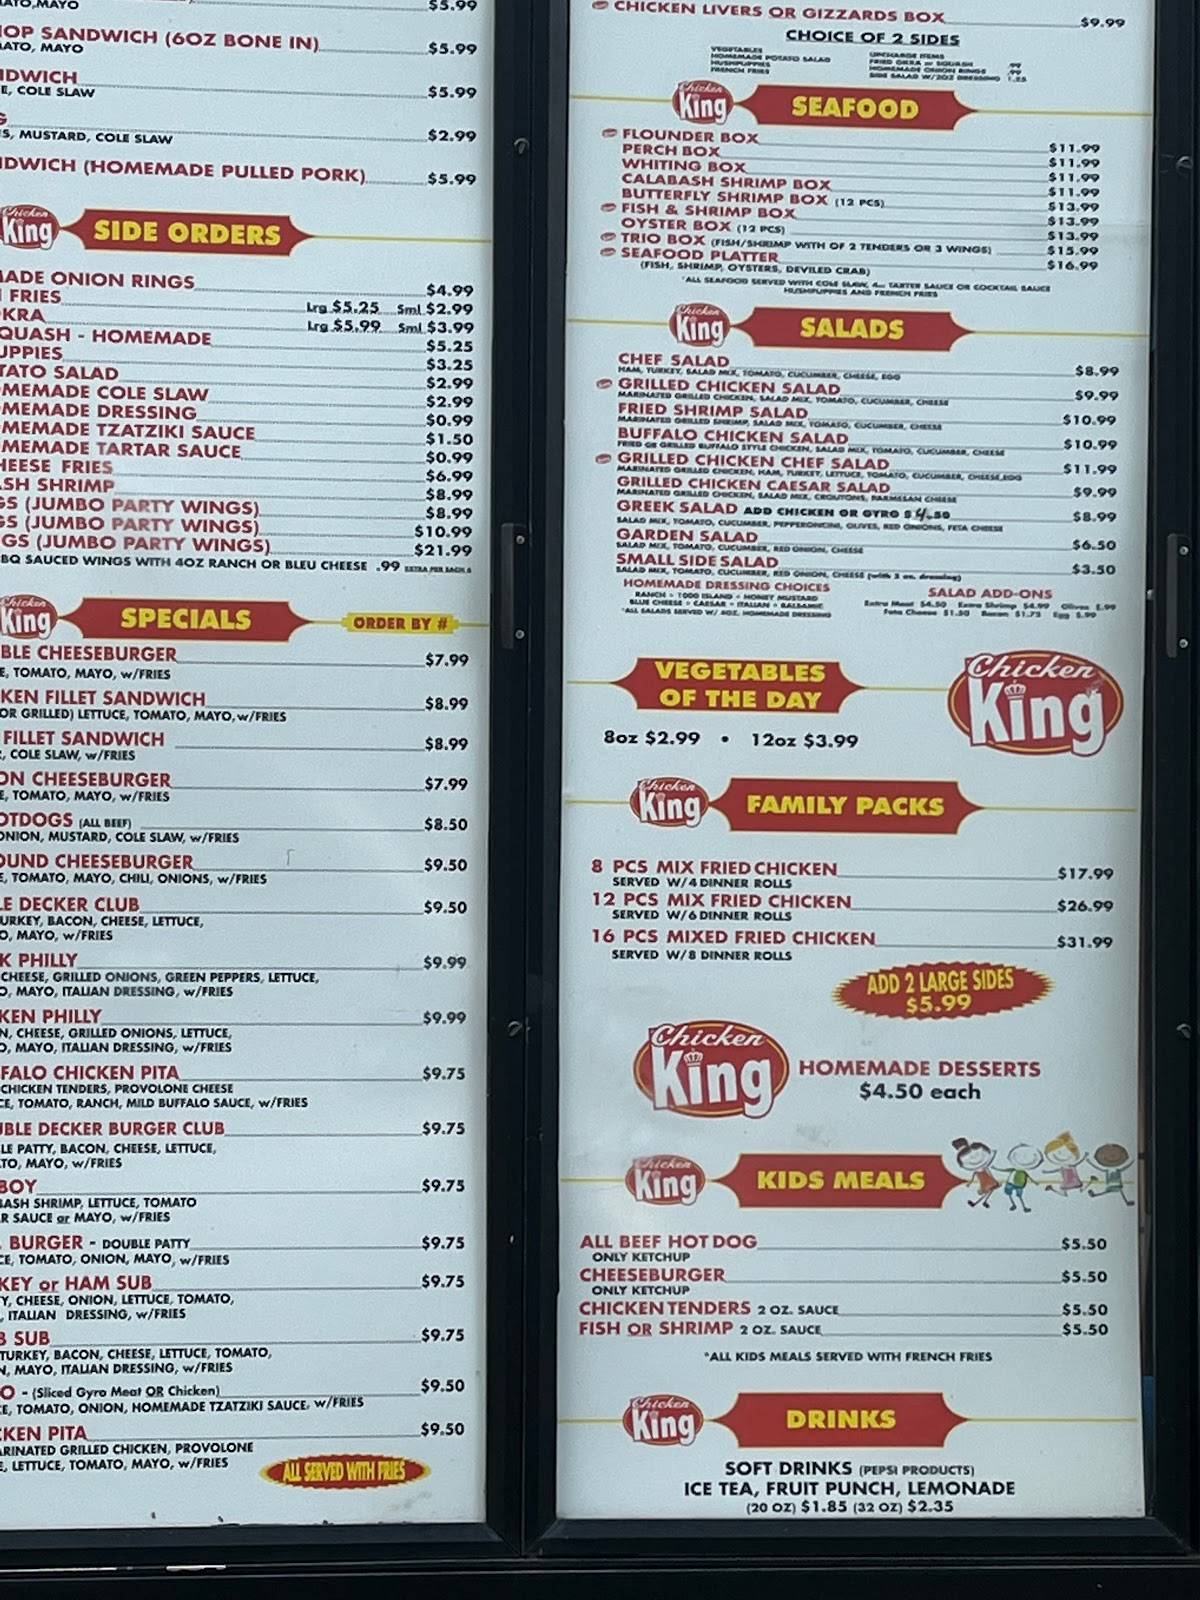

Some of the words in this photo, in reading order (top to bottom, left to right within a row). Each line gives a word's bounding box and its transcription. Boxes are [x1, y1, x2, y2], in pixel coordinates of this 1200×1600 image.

[614, 1, 695, 14] CHICKEN
[703, 4, 762, 17] LIVERS
[769, 7, 796, 19] OR
[803, 8, 897, 21] GIZZARDS
[904, 12, 945, 23] BOX
[1080, 17, 1125, 28] $9.99
[41, 27, 157, 44] SANDWICH
[224, 34, 281, 48] BONE
[290, 36, 319, 51] IN)
[428, 42, 477, 55] $5.99
[786, 29, 854, 44] CHOICE
[861, 31, 887, 44] OF
[892, 32, 903, 45] 2
[910, 33, 961, 47] SIDES
[679, 91, 727, 124] King
[792, 95, 919, 120] SEAFOOD
[623, 129, 714, 142] FLOUNDER
[721, 133, 759, 144] BOX
[1049, 143, 1100, 153] $11.99
[84, 160, 214, 177] (HOMEMADE
[222, 165, 294, 179] PULLED
[302, 167, 366, 184] PORK)
[428, 172, 476, 185] $5.99
[2, 216, 52, 250] King
[95, 219, 158, 242] SIDE
[168, 223, 281, 246] ORDERS
[640, 261, 673, 270] (FISH,
[728, 264, 782, 273] OYSTERS,
[786, 266, 832, 274] DEVILED
[836, 267, 870, 277] CRAB)
[51, 271, 124, 287] ONION
[132, 274, 194, 289] RINGS
[427, 283, 473, 297] $4.99
[10, 289, 61, 304] FRIES
[306, 302, 328, 315] Lrg
[332, 300, 380, 315] $5.25
[397, 304, 422, 316] Sml
[426, 302, 473, 315] $2.99
[676, 314, 724, 347] King
[801, 316, 905, 340] SALADS
[617, 500, 674, 512] GREEK
[680, 502, 737, 514] SALAD
[744, 507, 772, 515] ADD
[777, 508, 834, 517] CHICKEN
[839, 509, 858, 517] OR
[862, 510, 899, 518] GYRO
[1073, 511, 1116, 522] $8.99
[25, 516, 104, 533] (JUMBO
[112, 518, 174, 531] PARTY
[181, 519, 260, 537] WINGS)
[414, 524, 472, 538] $10.99
[25, 555, 78, 565] SAUCED
[83, 556, 131, 566] WINGS
[135, 557, 171, 566] WITH
[209, 559, 256, 569] RANCH
[261, 559, 280, 569] OR
[285, 560, 316, 570] BLEU
[321, 561, 367, 571] CHEESE
[376, 561, 400, 571] .99
[624, 579, 700, 588] HOMEMADE
[706, 581, 770, 590] DRESSING
[775, 583, 830, 592] CHOICES
[928, 588, 976, 598] SALAD
[981, 589, 1052, 599] ADD-ONS
[1, 606, 50, 638] King
[121, 607, 252, 631] SPECIALS
[353, 616, 406, 630] ORDER
[411, 617, 432, 630] BY
[437, 617, 447, 631] #
[37, 645, 177, 662] CHEESEBURGER
[426, 652, 469, 667] $7.99
[967, 655, 1094, 679] Chicken
[13, 667, 70, 679] TOMATO,
[75, 668, 116, 680] MAYO,
[121, 668, 170, 680] w/FRIES
[655, 660, 826, 683] VEGETABLES
[659, 688, 697, 707] OF
[704, 689, 757, 708] THE
[766, 690, 822, 710] DAY
[968, 676, 1104, 756] King
[604, 730, 638, 744] 8oz
[645, 730, 700, 746] $2.99
[752, 733, 796, 747] 12oz
[804, 733, 858, 749] $3.99
[639, 780, 696, 792] Chicken
[639, 790, 701, 827] King
[747, 794, 848, 815] FAMILY
[856, 796, 945, 817] PACKS
[593, 892, 615, 906] 12
[624, 893, 658, 906] PCS
[667, 893, 704, 907] MIX
[711, 894, 761, 907] FRIED
[768, 895, 852, 909] CHICKEN
[1057, 899, 1113, 912] $26.99
[53, 972, 101, 982] GRILLED
[105, 972, 161, 983] ONIONS,
[165, 972, 206, 982] GREEN
[210, 972, 264, 984] PEPPERS,
[269, 973, 319, 984] LETTUCE,
[867, 972, 900, 995] ADD
[905, 972, 915, 993] 2
[919, 970, 969, 993] LARGE
[972, 968, 1014, 991] SIDES
[906, 994, 972, 1015] $5.99
[651, 1024, 765, 1048] Chicken
[800, 1060, 930, 1076] HOMEMADE
[939, 1061, 1040, 1077] DESSERTS
[651, 1044, 773, 1119] King
[860, 1081, 923, 1101] $4.50
[930, 1083, 981, 1099] each
[635, 1168, 697, 1206] King
[757, 1170, 825, 1190] KIDS
[833, 1171, 925, 1190] MEALS
[580, 1321, 620, 1335] FISH
[628, 1323, 652, 1336] OR
[659, 1321, 733, 1335] SHRIMP
[740, 1325, 748, 1335] 2
[752, 1325, 774, 1335] OZ.
[780, 1325, 821, 1336] SAUCE
[1063, 1322, 1108, 1336] $5.50
[32, 1386, 72, 1400] (Sliced
[76, 1387, 107, 1400] Gyro
[111, 1386, 142, 1398] Meat
[146, 1386, 164, 1398] OR
[168, 1385, 220, 1396] Chicken)
[421, 1378, 465, 1394] $9.50
[632, 1397, 690, 1409] Chicken
[632, 1407, 695, 1446] King
[787, 1409, 897, 1429] DRINKS
[283, 1462, 302, 1482] ALL
[304, 1461, 344, 1482] SERVED
[346, 1460, 375, 1481] WITH
[378, 1460, 406, 1481] FRIES
[725, 1461, 773, 1476] SOFT
[779, 1461, 852, 1475] DRINKS
[859, 1465, 898, 1477] (PEPSI
[902, 1464, 975, 1478] PRODUCTS)
[685, 1482, 712, 1496] ICE
[718, 1482, 759, 1498] TEA,
[767, 1482, 819, 1495] FRUIT
[826, 1481, 900, 1497] PUNCH,
[908, 1481, 1015, 1495] LEMONADE
[747, 1503, 767, 1512] (20
[773, 1503, 795, 1511] OZ)
[802, 1500, 846, 1512] $1.85
[859, 1503, 873, 1511] (32
[879, 1503, 902, 1511] OZ)
[908, 1499, 953, 1512] $2.35
